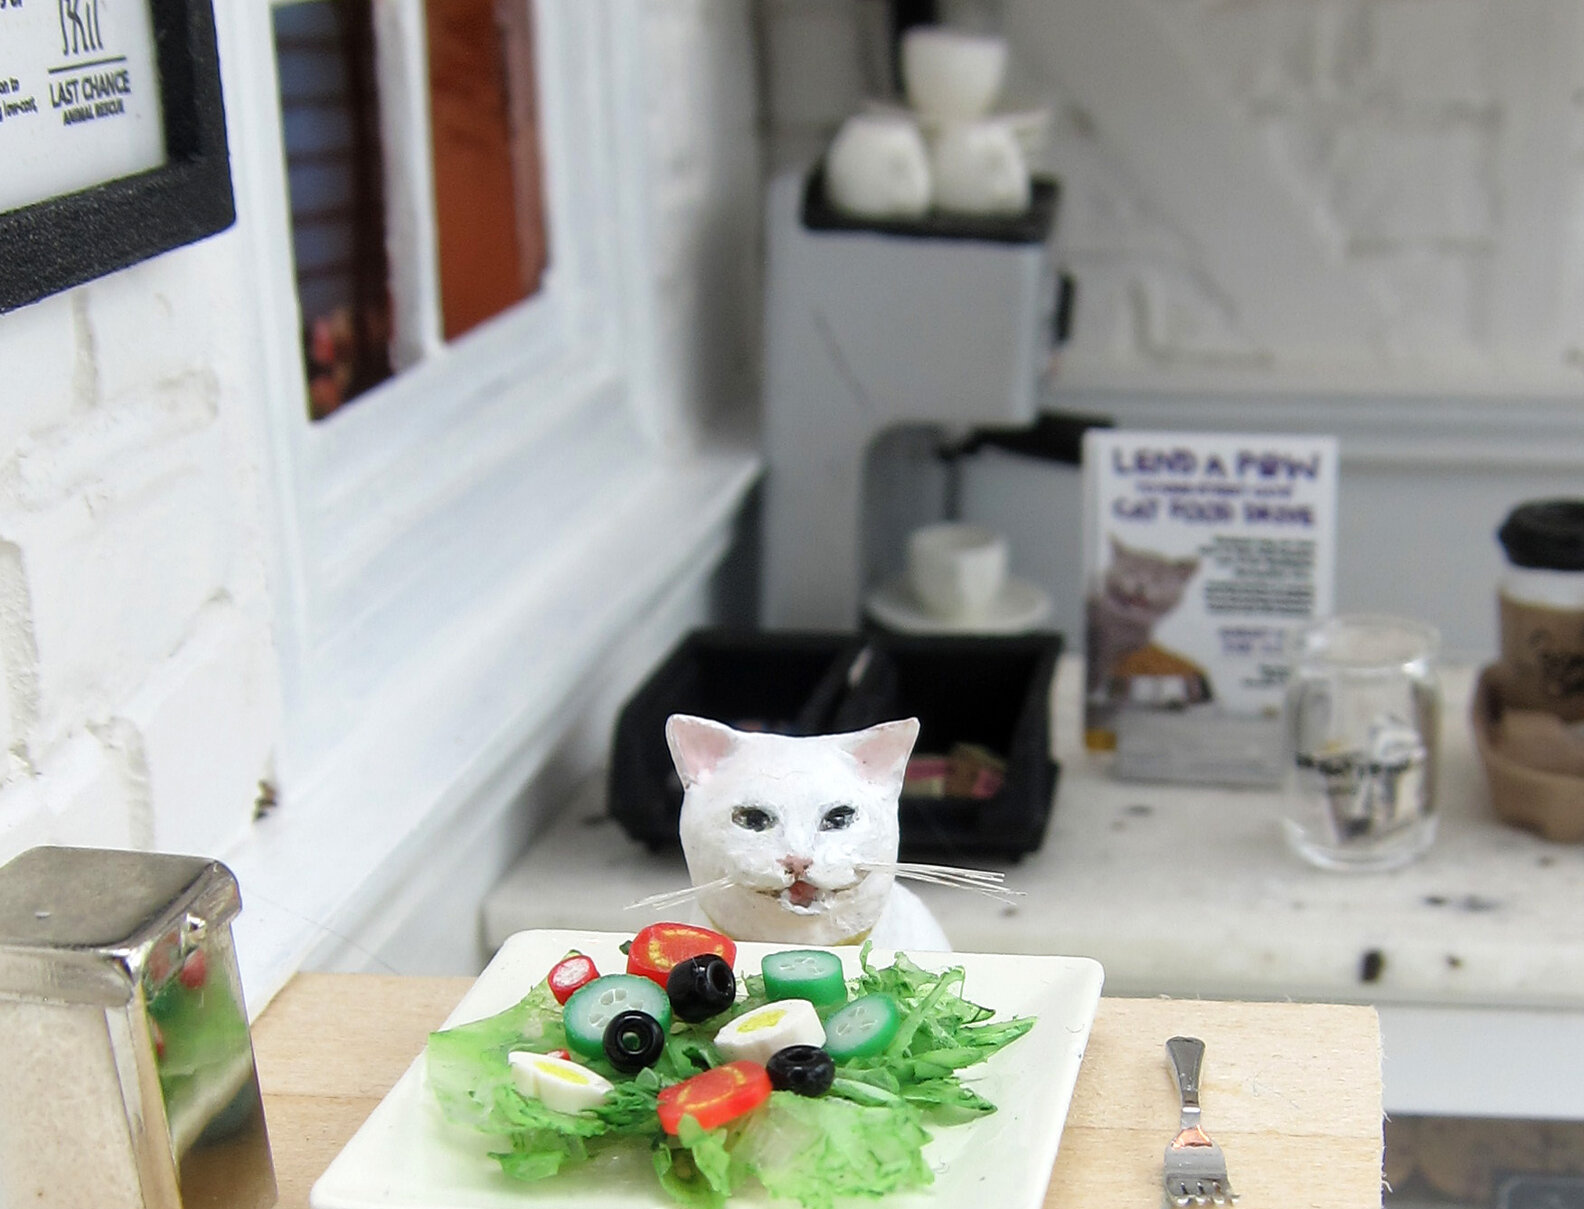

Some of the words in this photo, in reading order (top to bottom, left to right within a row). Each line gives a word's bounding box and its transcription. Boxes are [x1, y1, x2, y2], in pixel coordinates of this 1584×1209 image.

[49, 78, 79, 108] LAST
[82, 69, 131, 100] CHANCE
[63, 104, 94, 126] ANIMAL
[94, 98, 125, 118] RESCUE
[1112, 448, 1197, 475] LEND
[1205, 454, 1226, 476] A
[1112, 497, 1158, 521] CAT
[1168, 499, 1235, 524] FOOD
